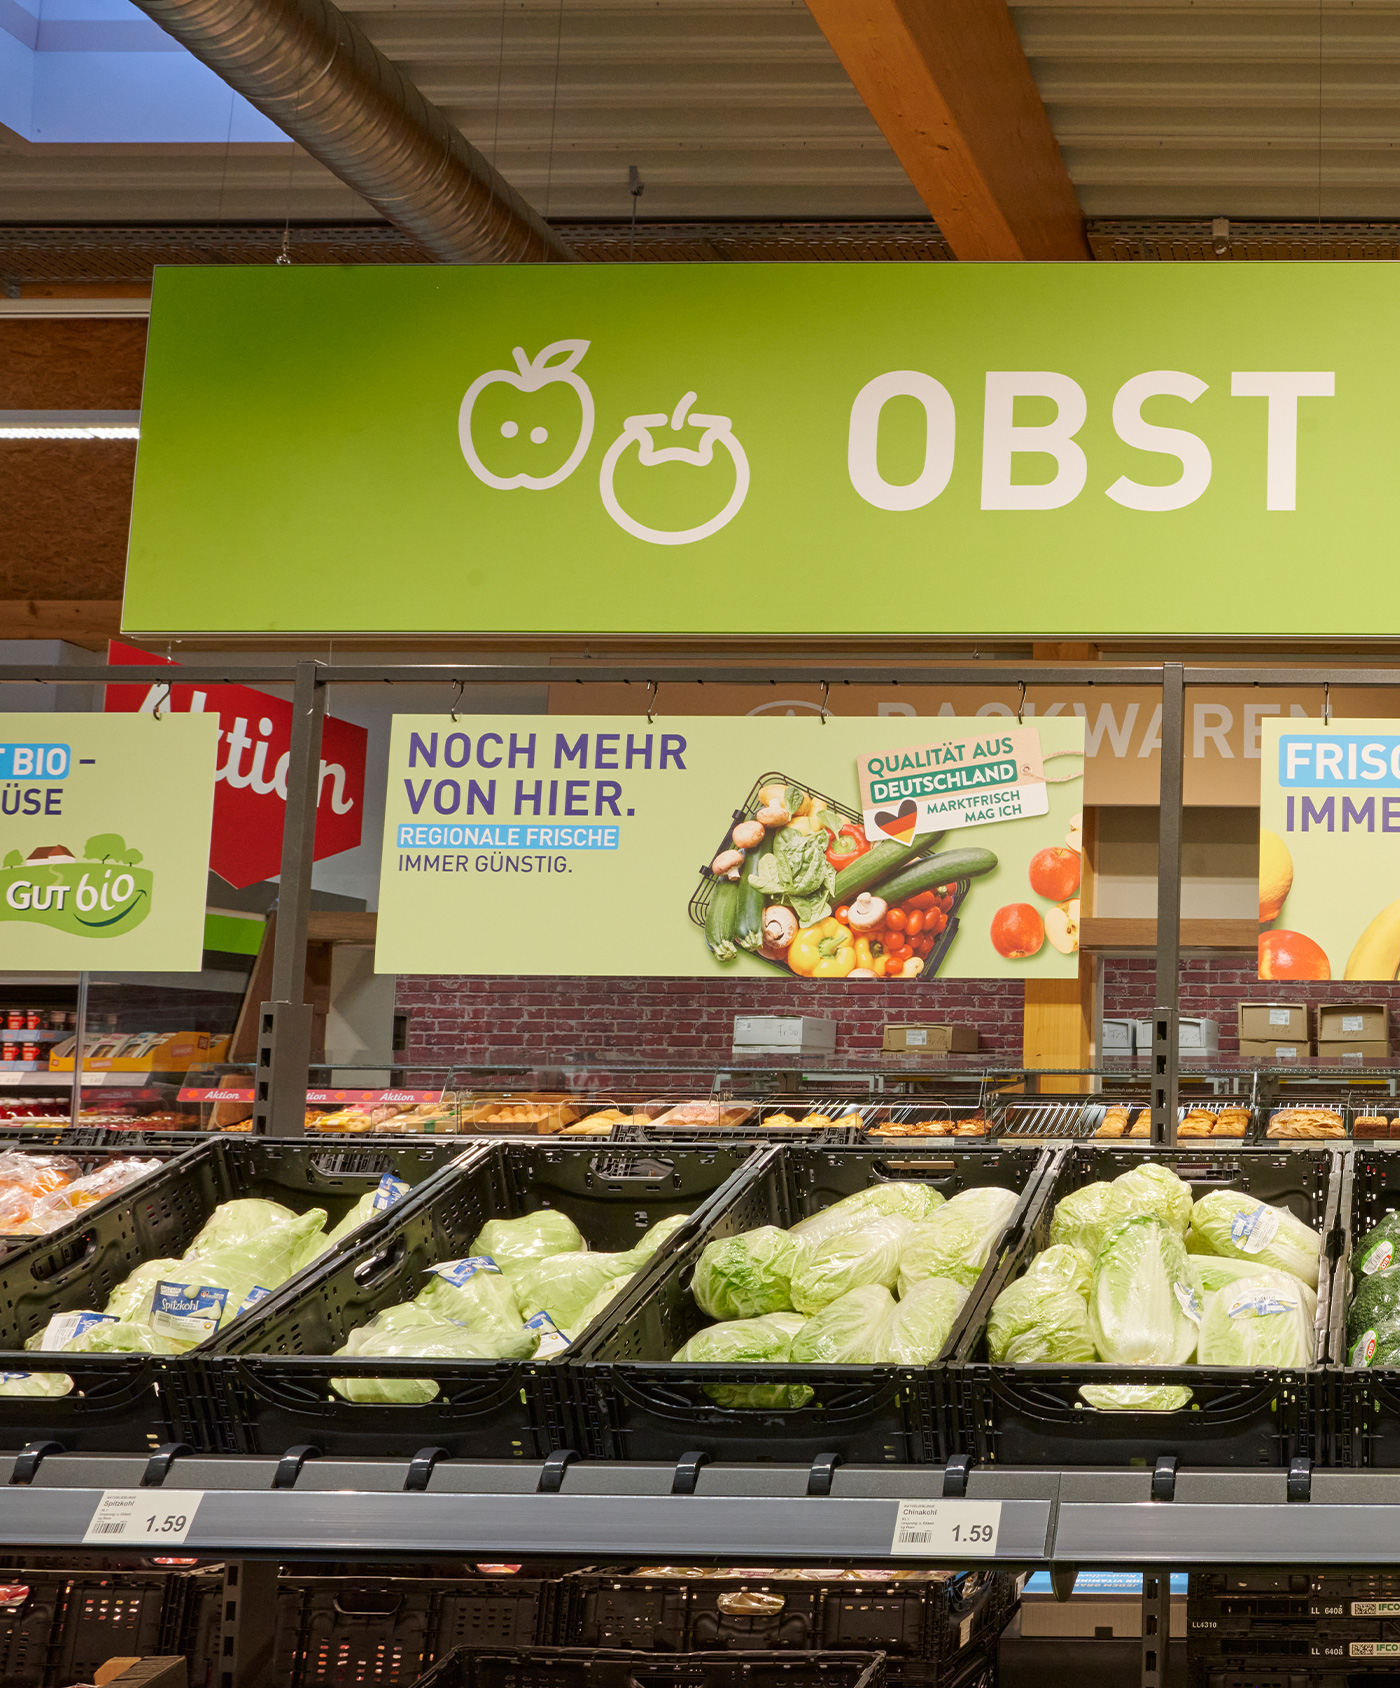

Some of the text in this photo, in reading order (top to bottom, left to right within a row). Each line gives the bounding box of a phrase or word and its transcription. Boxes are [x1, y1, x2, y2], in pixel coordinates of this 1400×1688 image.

[848, 370, 1335, 512] OBST
[12, 748, 67, 776] BIO
[408, 732, 687, 770] NOCH MEHR
[867, 737, 1014, 777] QUALITÄT AUS
[873, 764, 1014, 800] DEUTSCHLAND
[404, 779, 635, 816] VON HIER.
[926, 790, 1020, 815] MARKTFRISCH
[964, 803, 1022, 823] MAG ICH
[400, 827, 617, 847] REGIONALE FRISCHE
[398, 851, 572, 873] IMMER GÜNSTIG.
[6, 880, 71, 911] GUT
[204, 1090, 240, 1099] Aktion
[379, 1091, 415, 1101] Aktion
[162, 1298, 199, 1313] Spitzkohl
[146, 1515, 187, 1532] 1.59
[952, 1524, 993, 1542] 1.59
[1325, 1607, 1343, 1615] 6408
